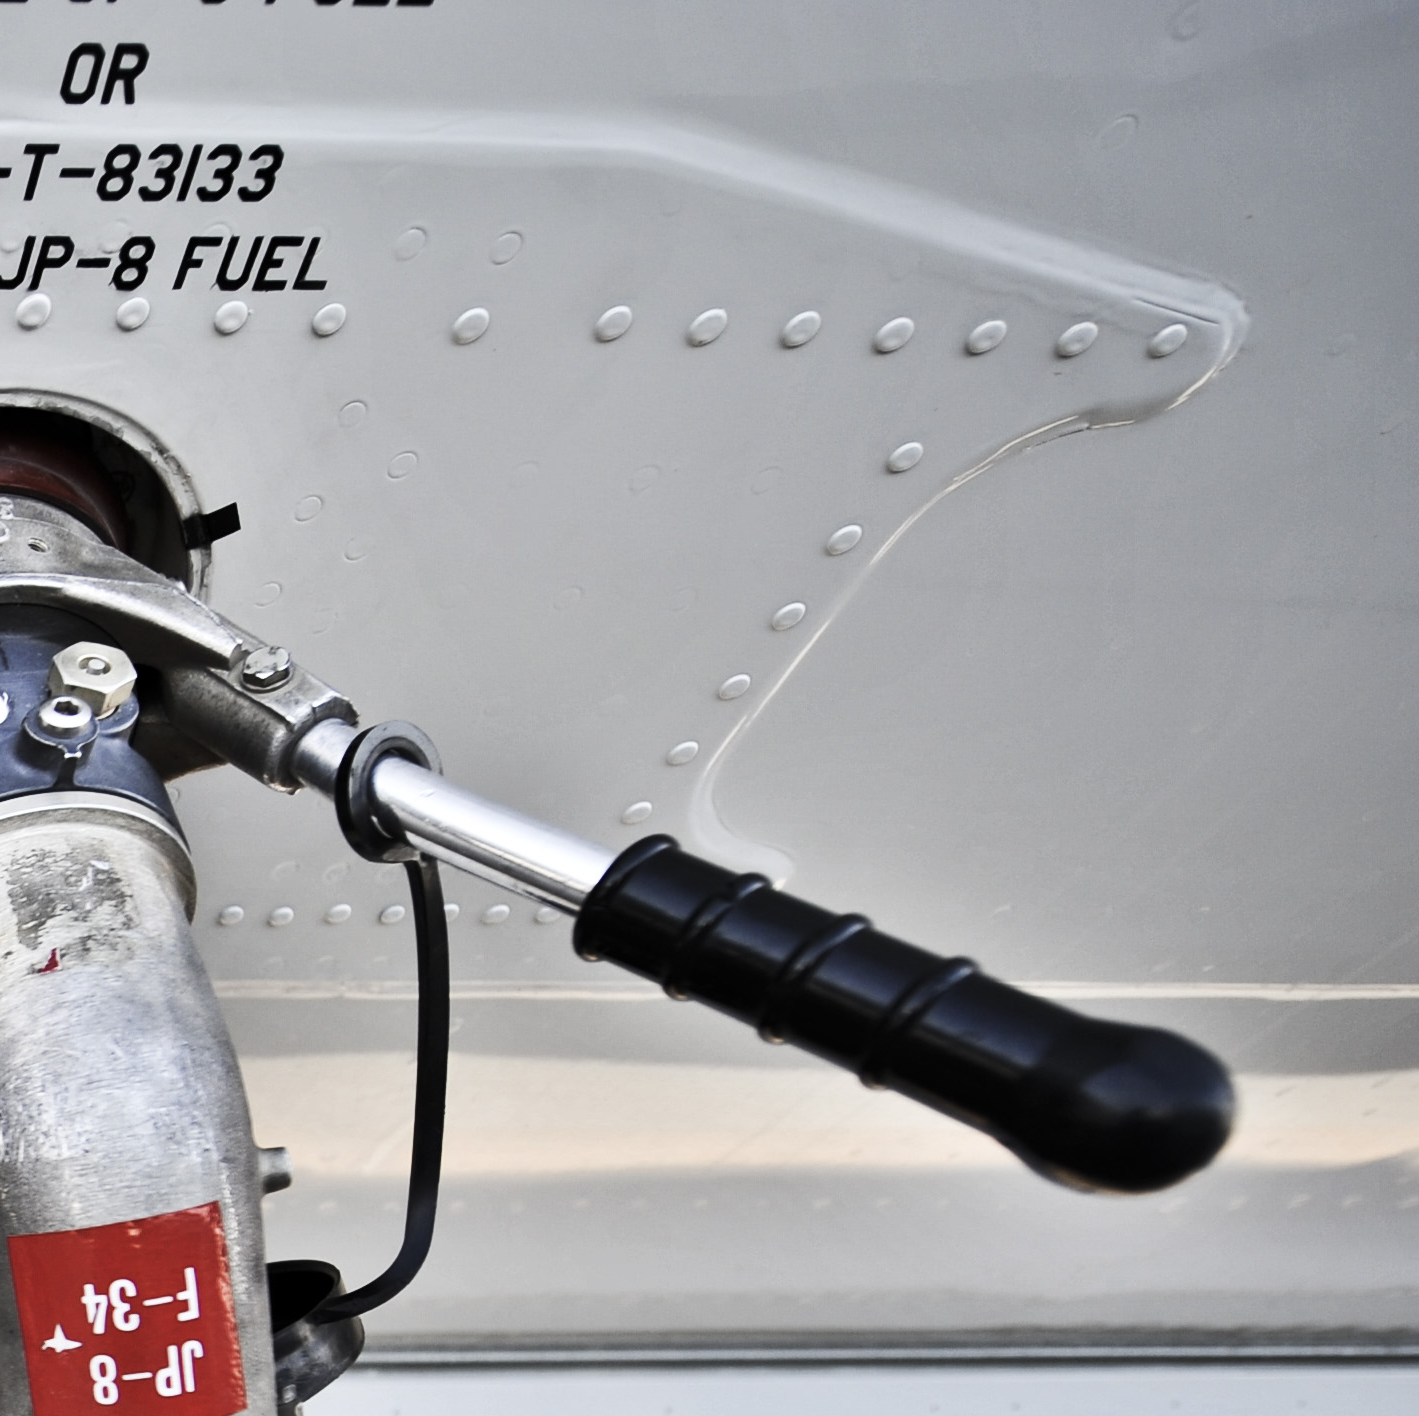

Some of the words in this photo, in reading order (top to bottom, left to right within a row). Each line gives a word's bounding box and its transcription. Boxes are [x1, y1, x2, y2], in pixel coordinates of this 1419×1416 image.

[60, 43, 149, 104] OR
[172, 236, 329, 292] FUEL
[81, 1267, 200, 1334] F-34
[89, 1340, 204, 1405] JP-8
